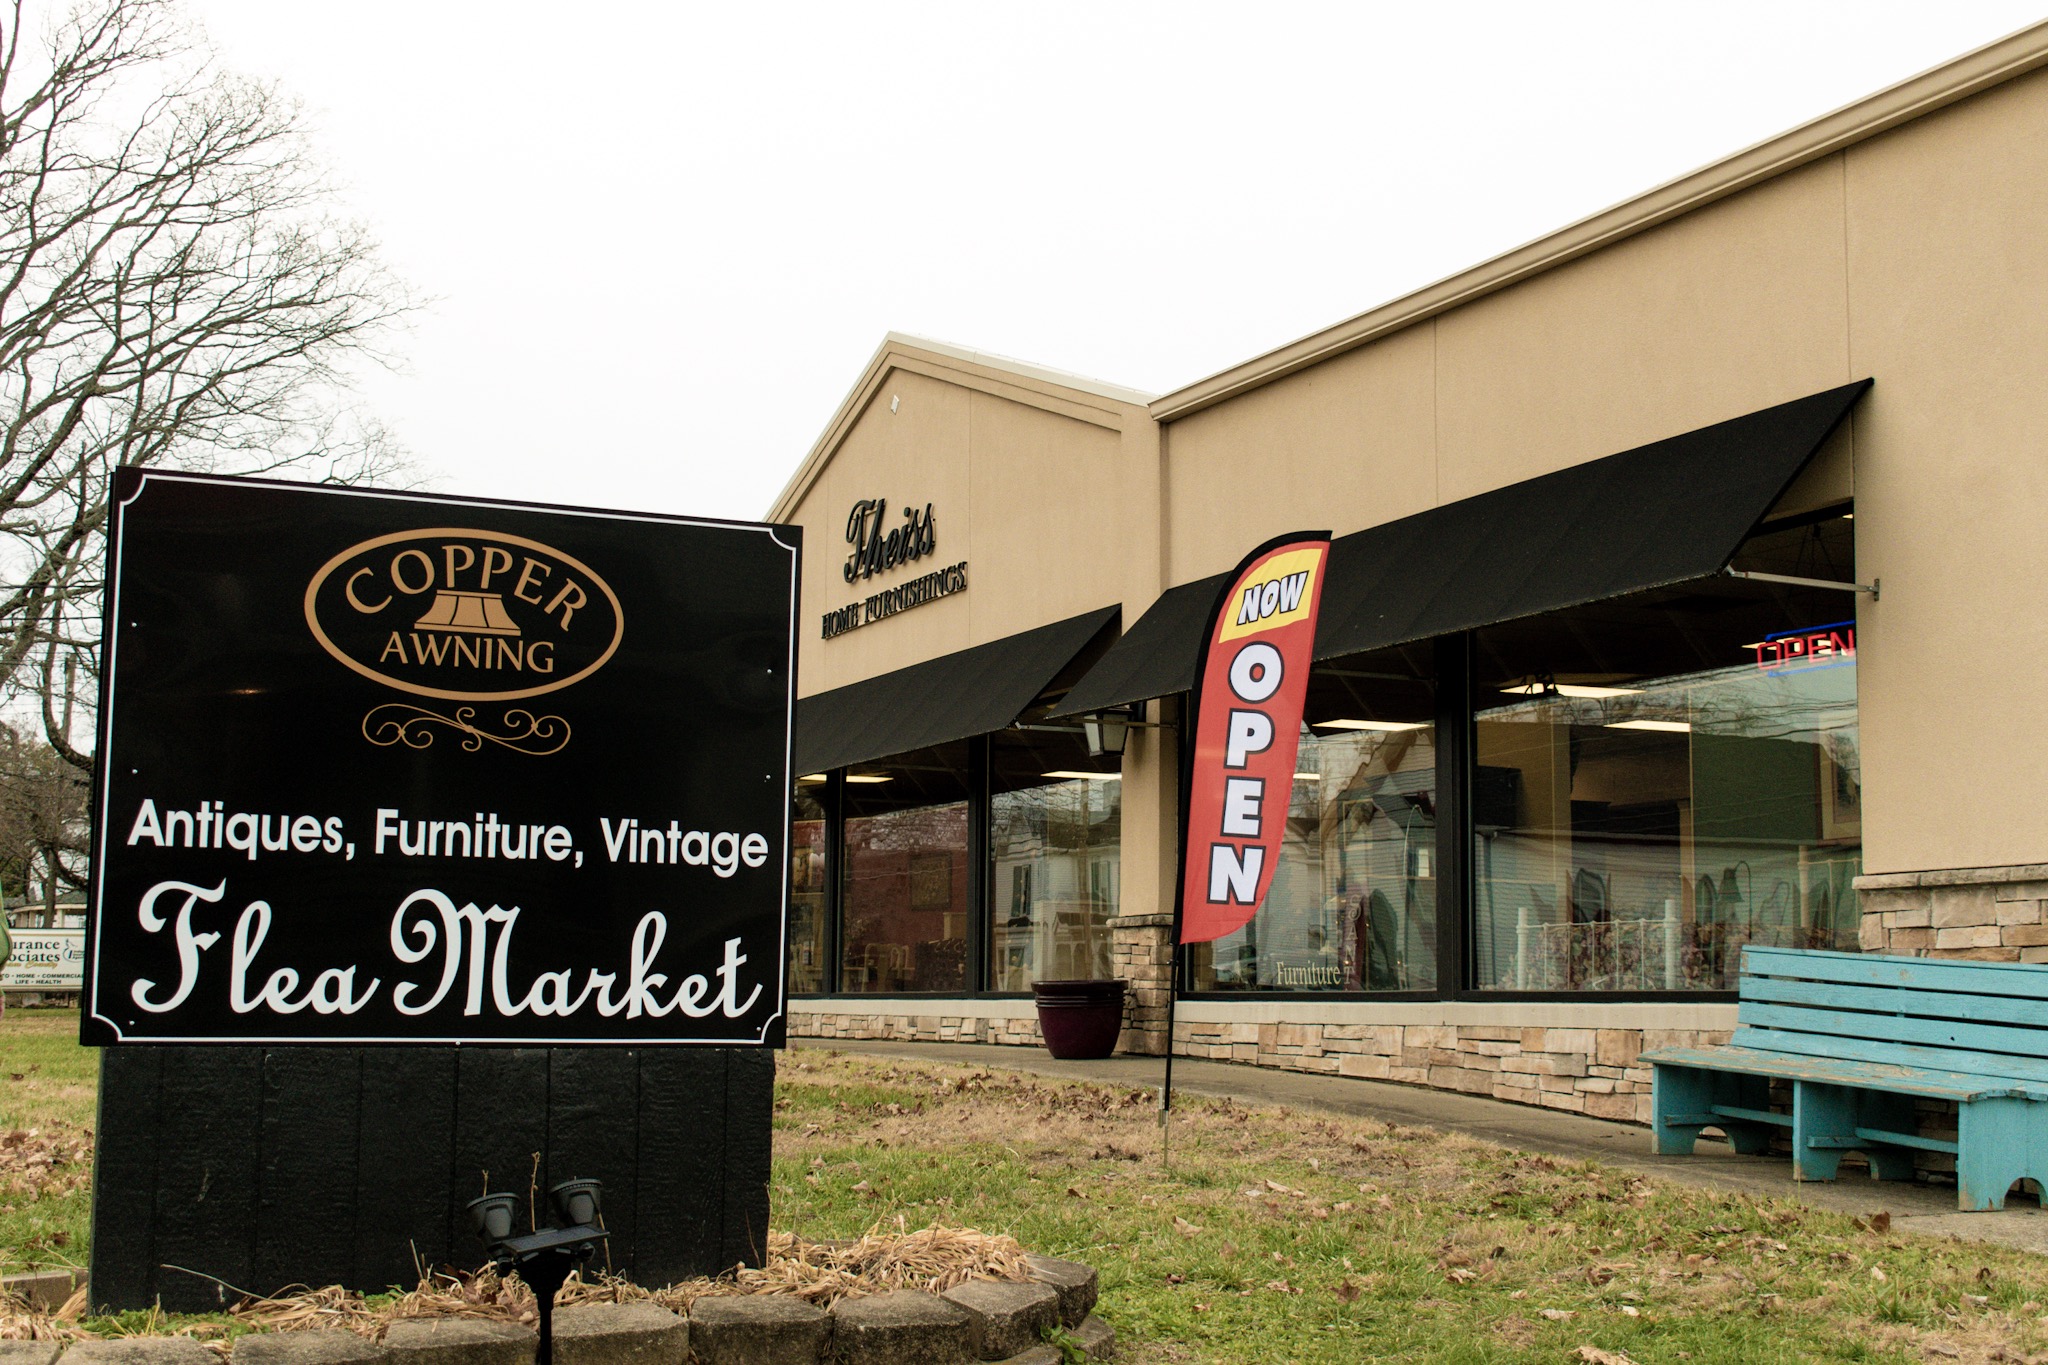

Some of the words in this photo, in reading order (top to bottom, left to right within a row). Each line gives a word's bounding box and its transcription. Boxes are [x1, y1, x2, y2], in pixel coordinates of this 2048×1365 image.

[844, 498, 933, 583] Theiss
[345, 545, 588, 632] COPPER
[821, 602, 859, 639] HOME
[864, 561, 968, 623] FURNISHINGS
[1236, 570, 1309, 626] NOW
[379, 631, 555, 674] AWNING
[1757, 629, 1855, 670] OPEN
[1206, 641, 1284, 905] OPEN
[127, 799, 355, 860] Antiques,
[375, 808, 584, 868] Furniture,
[601, 818, 768, 878] Vintage
[131, 877, 381, 1014] Flea
[390, 888, 763, 1020] Market
[1277, 960, 1342, 985] Furniture
